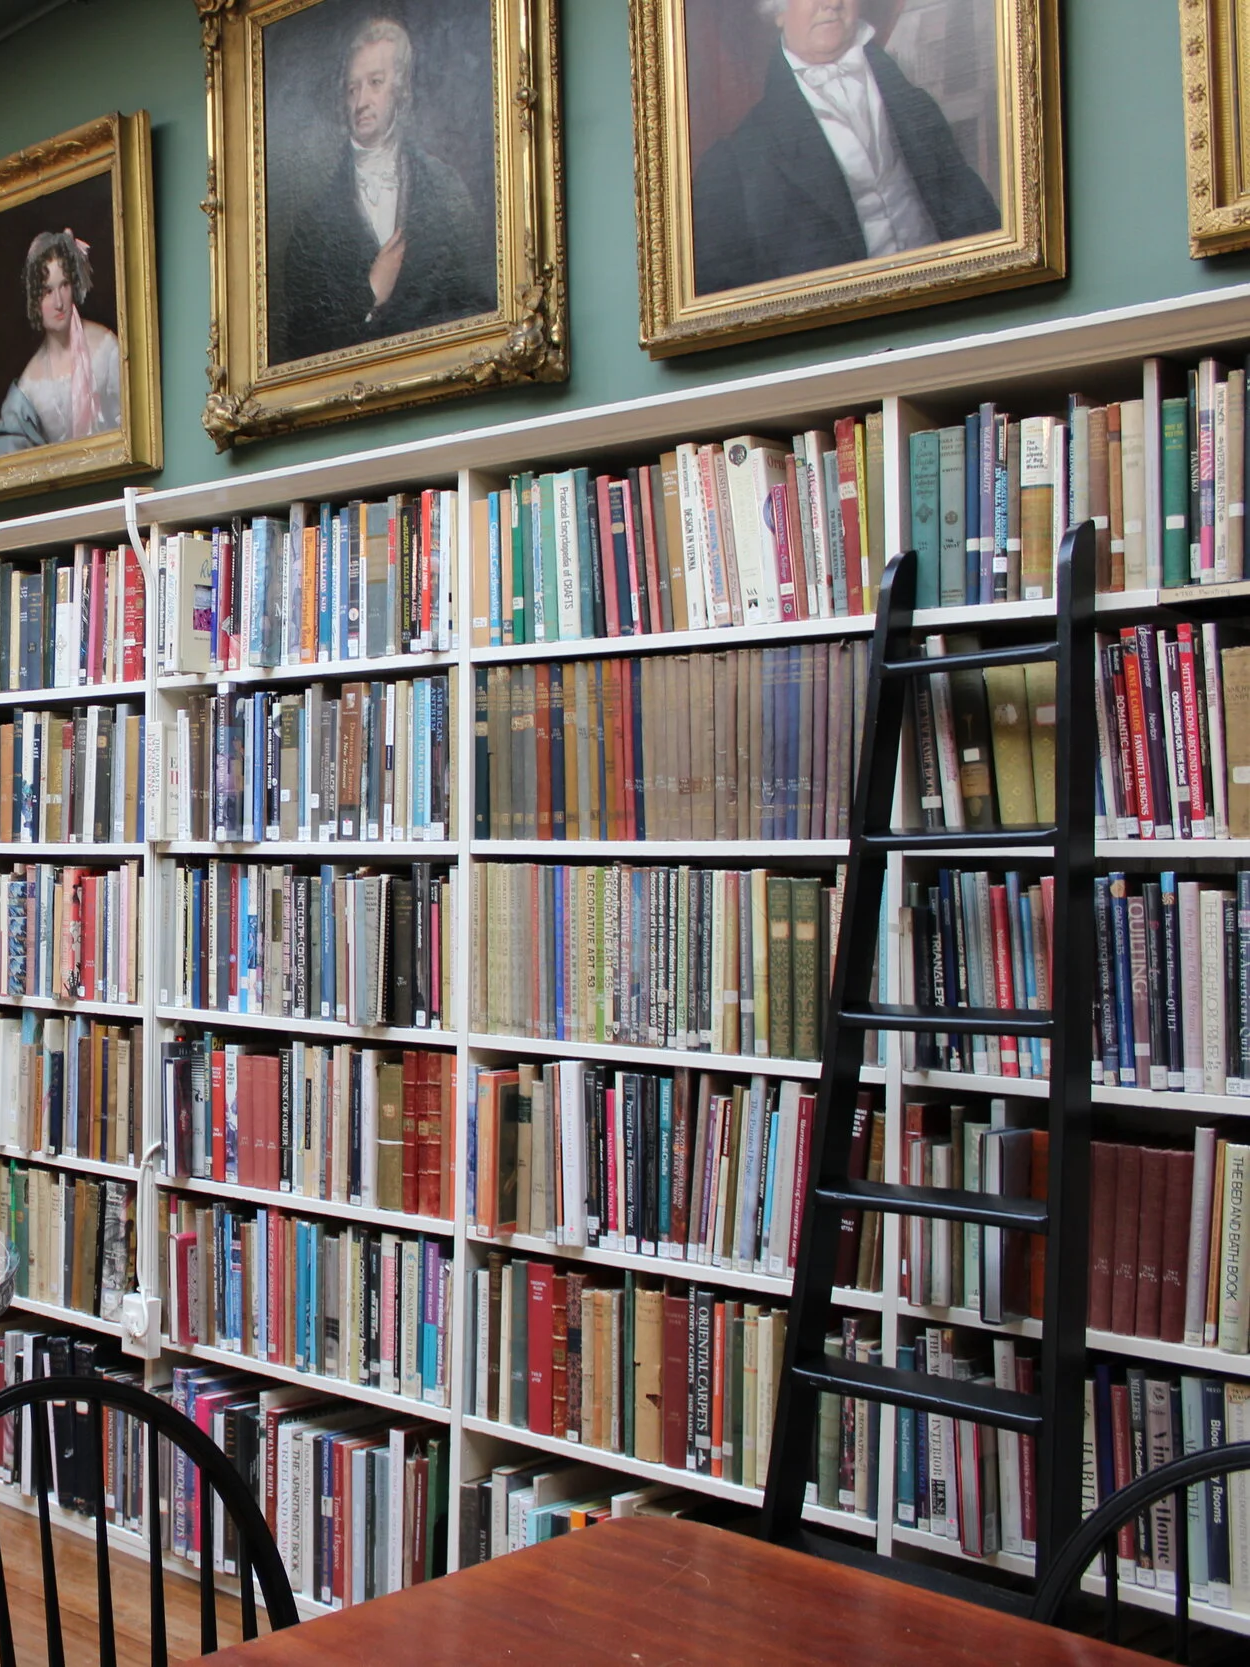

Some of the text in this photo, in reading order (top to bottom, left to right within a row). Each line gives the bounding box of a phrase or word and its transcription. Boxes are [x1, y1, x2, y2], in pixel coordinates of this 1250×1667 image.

[983, 450, 990, 460] IN
[1200, 421, 1212, 481] TARTANS
[1217, 445, 1225, 484] WEAVING
[560, 487, 570, 518] Practical
[684, 508, 693, 534] DESIGN
[1217, 496, 1225, 514] FUN
[560, 521, 571, 567] Encyclopedia
[687, 545, 696, 571] VIENNA
[564, 579, 573, 610] CRAFTS
[1127, 664, 1137, 689] ARNE
[1138, 627, 1157, 741] designing knitwear Newton
[1116, 695, 1129, 746] ROMANTIC
[1131, 698, 1142, 731] CARLOS
[1134, 734, 1145, 777] FAVORITE
[1171, 691, 1186, 785] CROCHETING FOR THE HOME
[1181, 662, 1201, 811] MITTENS FROM AROUND NORWAY
[1137, 778, 1148, 816] DESIGNS
[1097, 884, 1106, 931] AMERICAN
[1225, 907, 1233, 932] AMISH
[621, 872, 629, 1011] DECORATIVE ART 1967/68
[1128, 903, 1146, 993] QUILTING
[1099, 936, 1109, 991] PATCHWORK
[1205, 901, 1219, 1058] THE PERFECT PATCHWORK PRIMER
[1240, 932, 1250, 1062] The American Quilt
[1102, 1003, 1112, 1044] QUILTING
[282, 1103, 289, 1113] OF
[750, 1099, 758, 1120] The
[1226, 1158, 1244, 1301] THE BED AND BATH BOOK
[268, 1261, 273, 1272] OF
[406, 1285, 414, 1344] ORNAMENTED
[688, 1333, 694, 1344] OF
[930, 1334, 939, 1359] THE
[696, 1307, 709, 1431] ORIENTAL CARPETS
[1131, 1378, 1141, 1420] MILLER'S
[932, 1419, 941, 1476] INTERIOR
[176, 1502, 185, 1538] QUILTS
[292, 1474, 300, 1538] APARTMENT
[1212, 1486, 1222, 1523] Rooms
[1156, 1509, 1171, 1564] Home
[291, 1542, 300, 1574] BOOK
